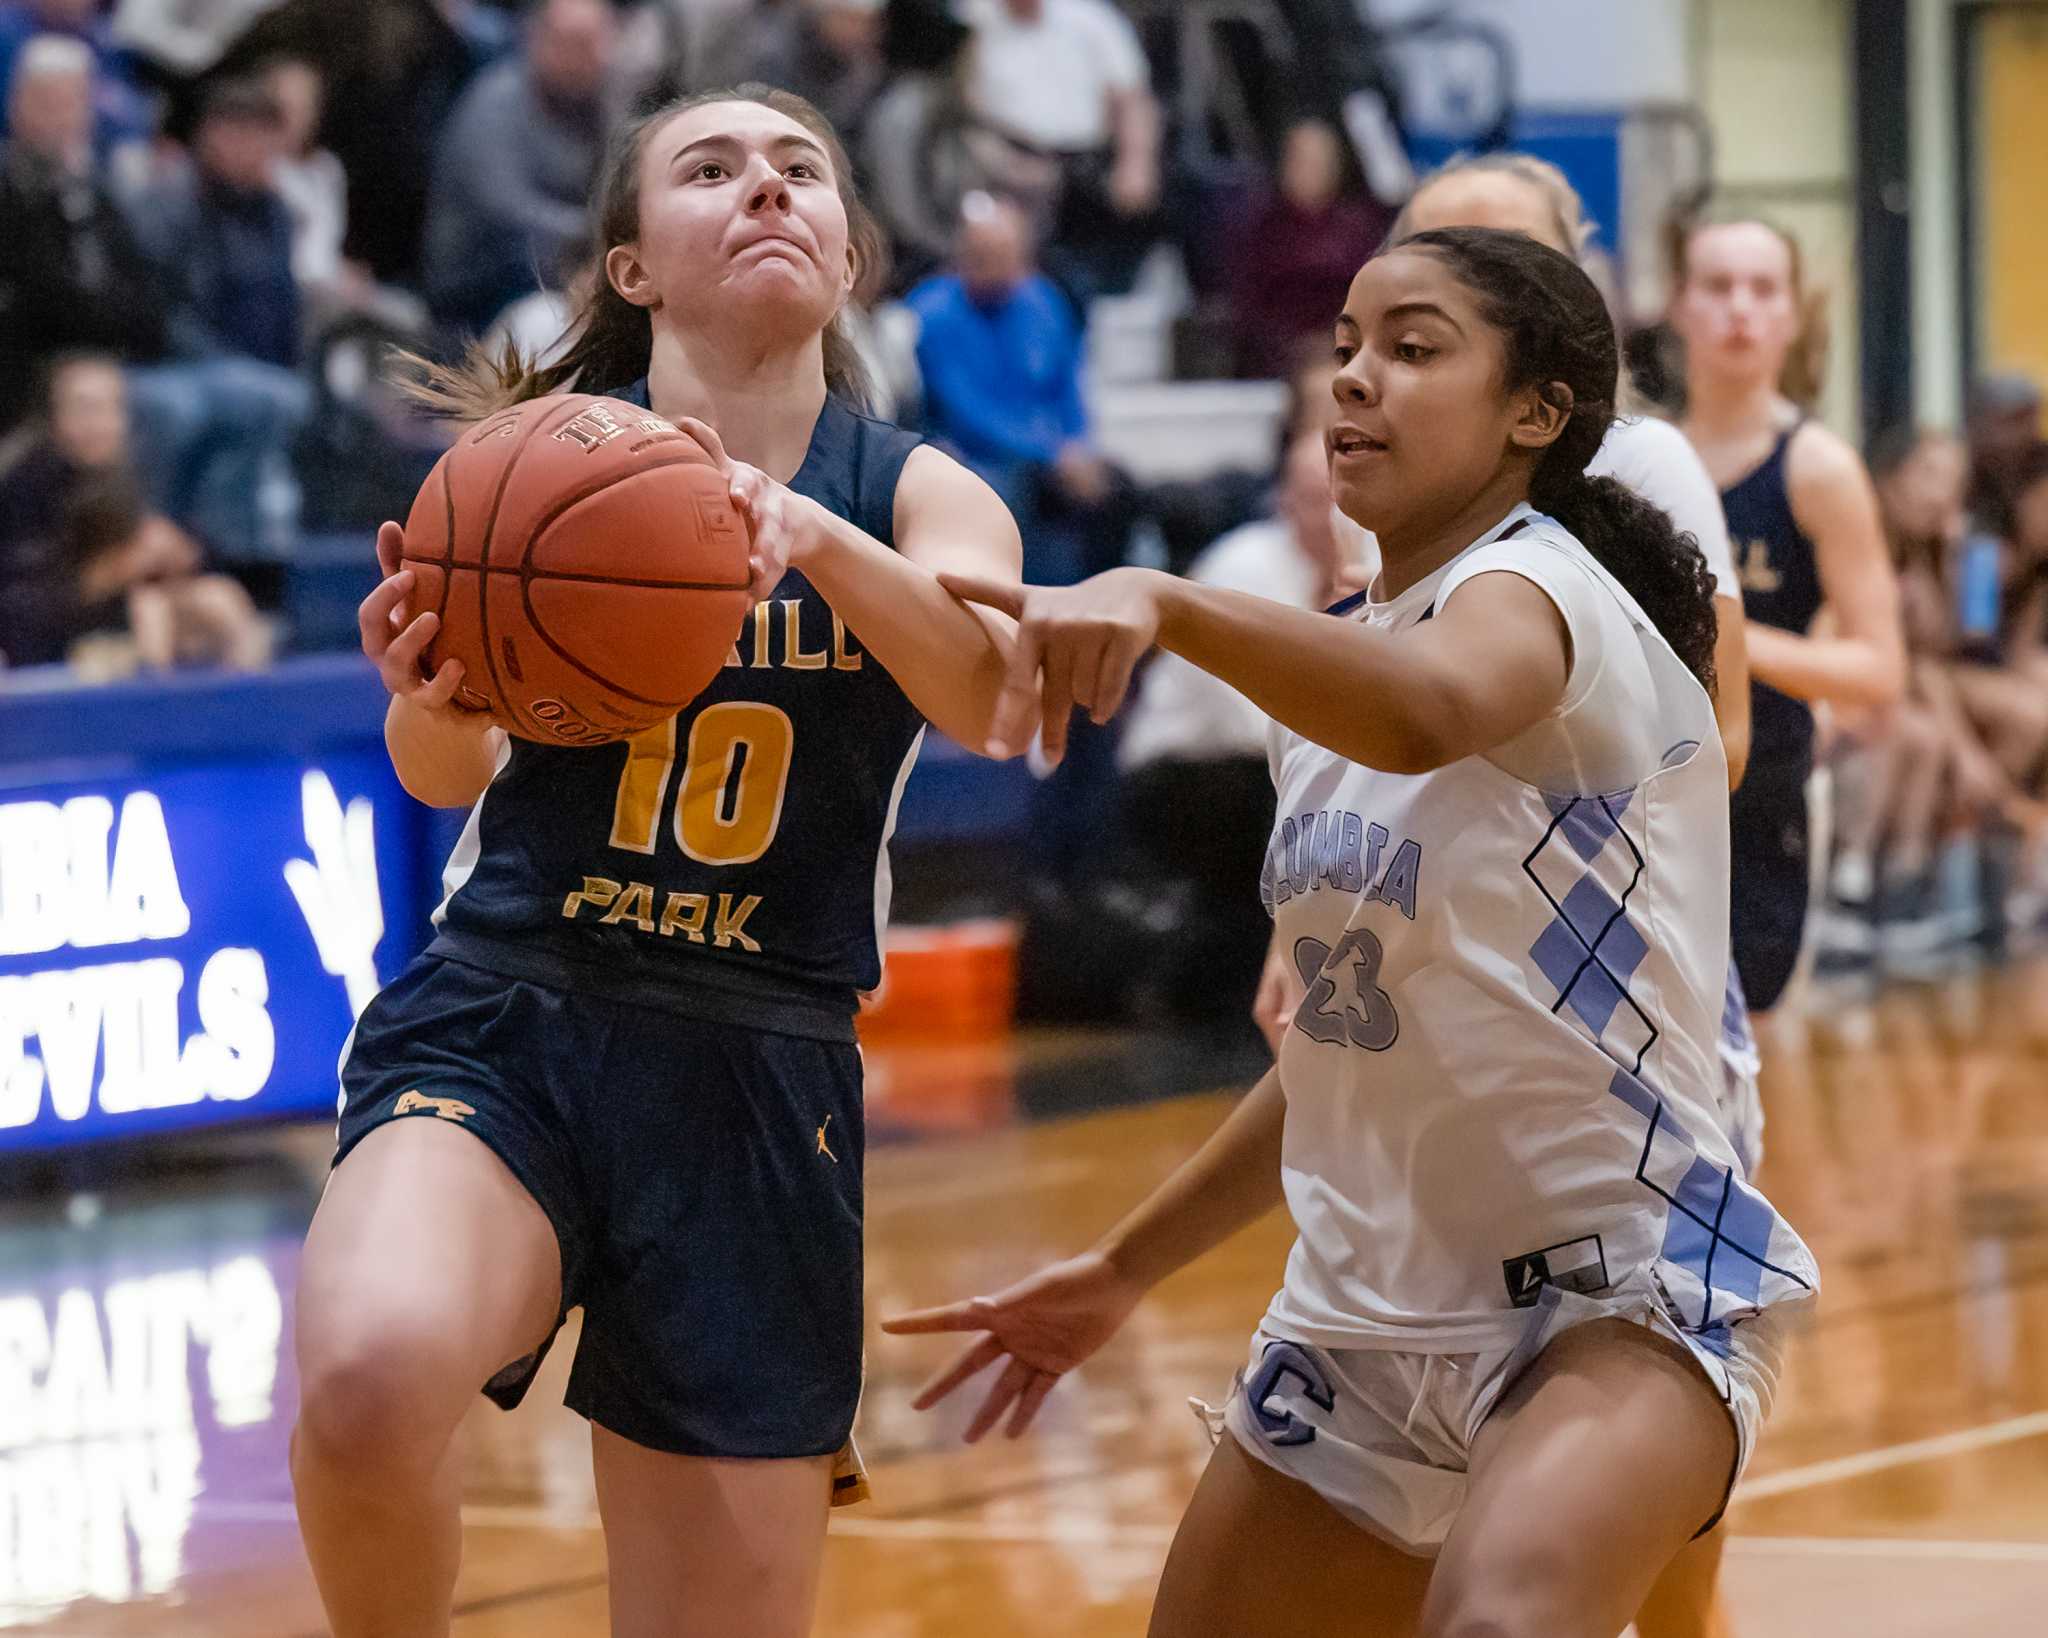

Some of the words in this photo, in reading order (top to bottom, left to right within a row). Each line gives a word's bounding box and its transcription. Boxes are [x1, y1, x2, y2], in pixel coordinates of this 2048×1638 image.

[725, 598, 863, 671] ILL
[608, 700, 794, 866] 10
[561, 876, 764, 952] PARK
[1294, 928, 1399, 1051] 23
